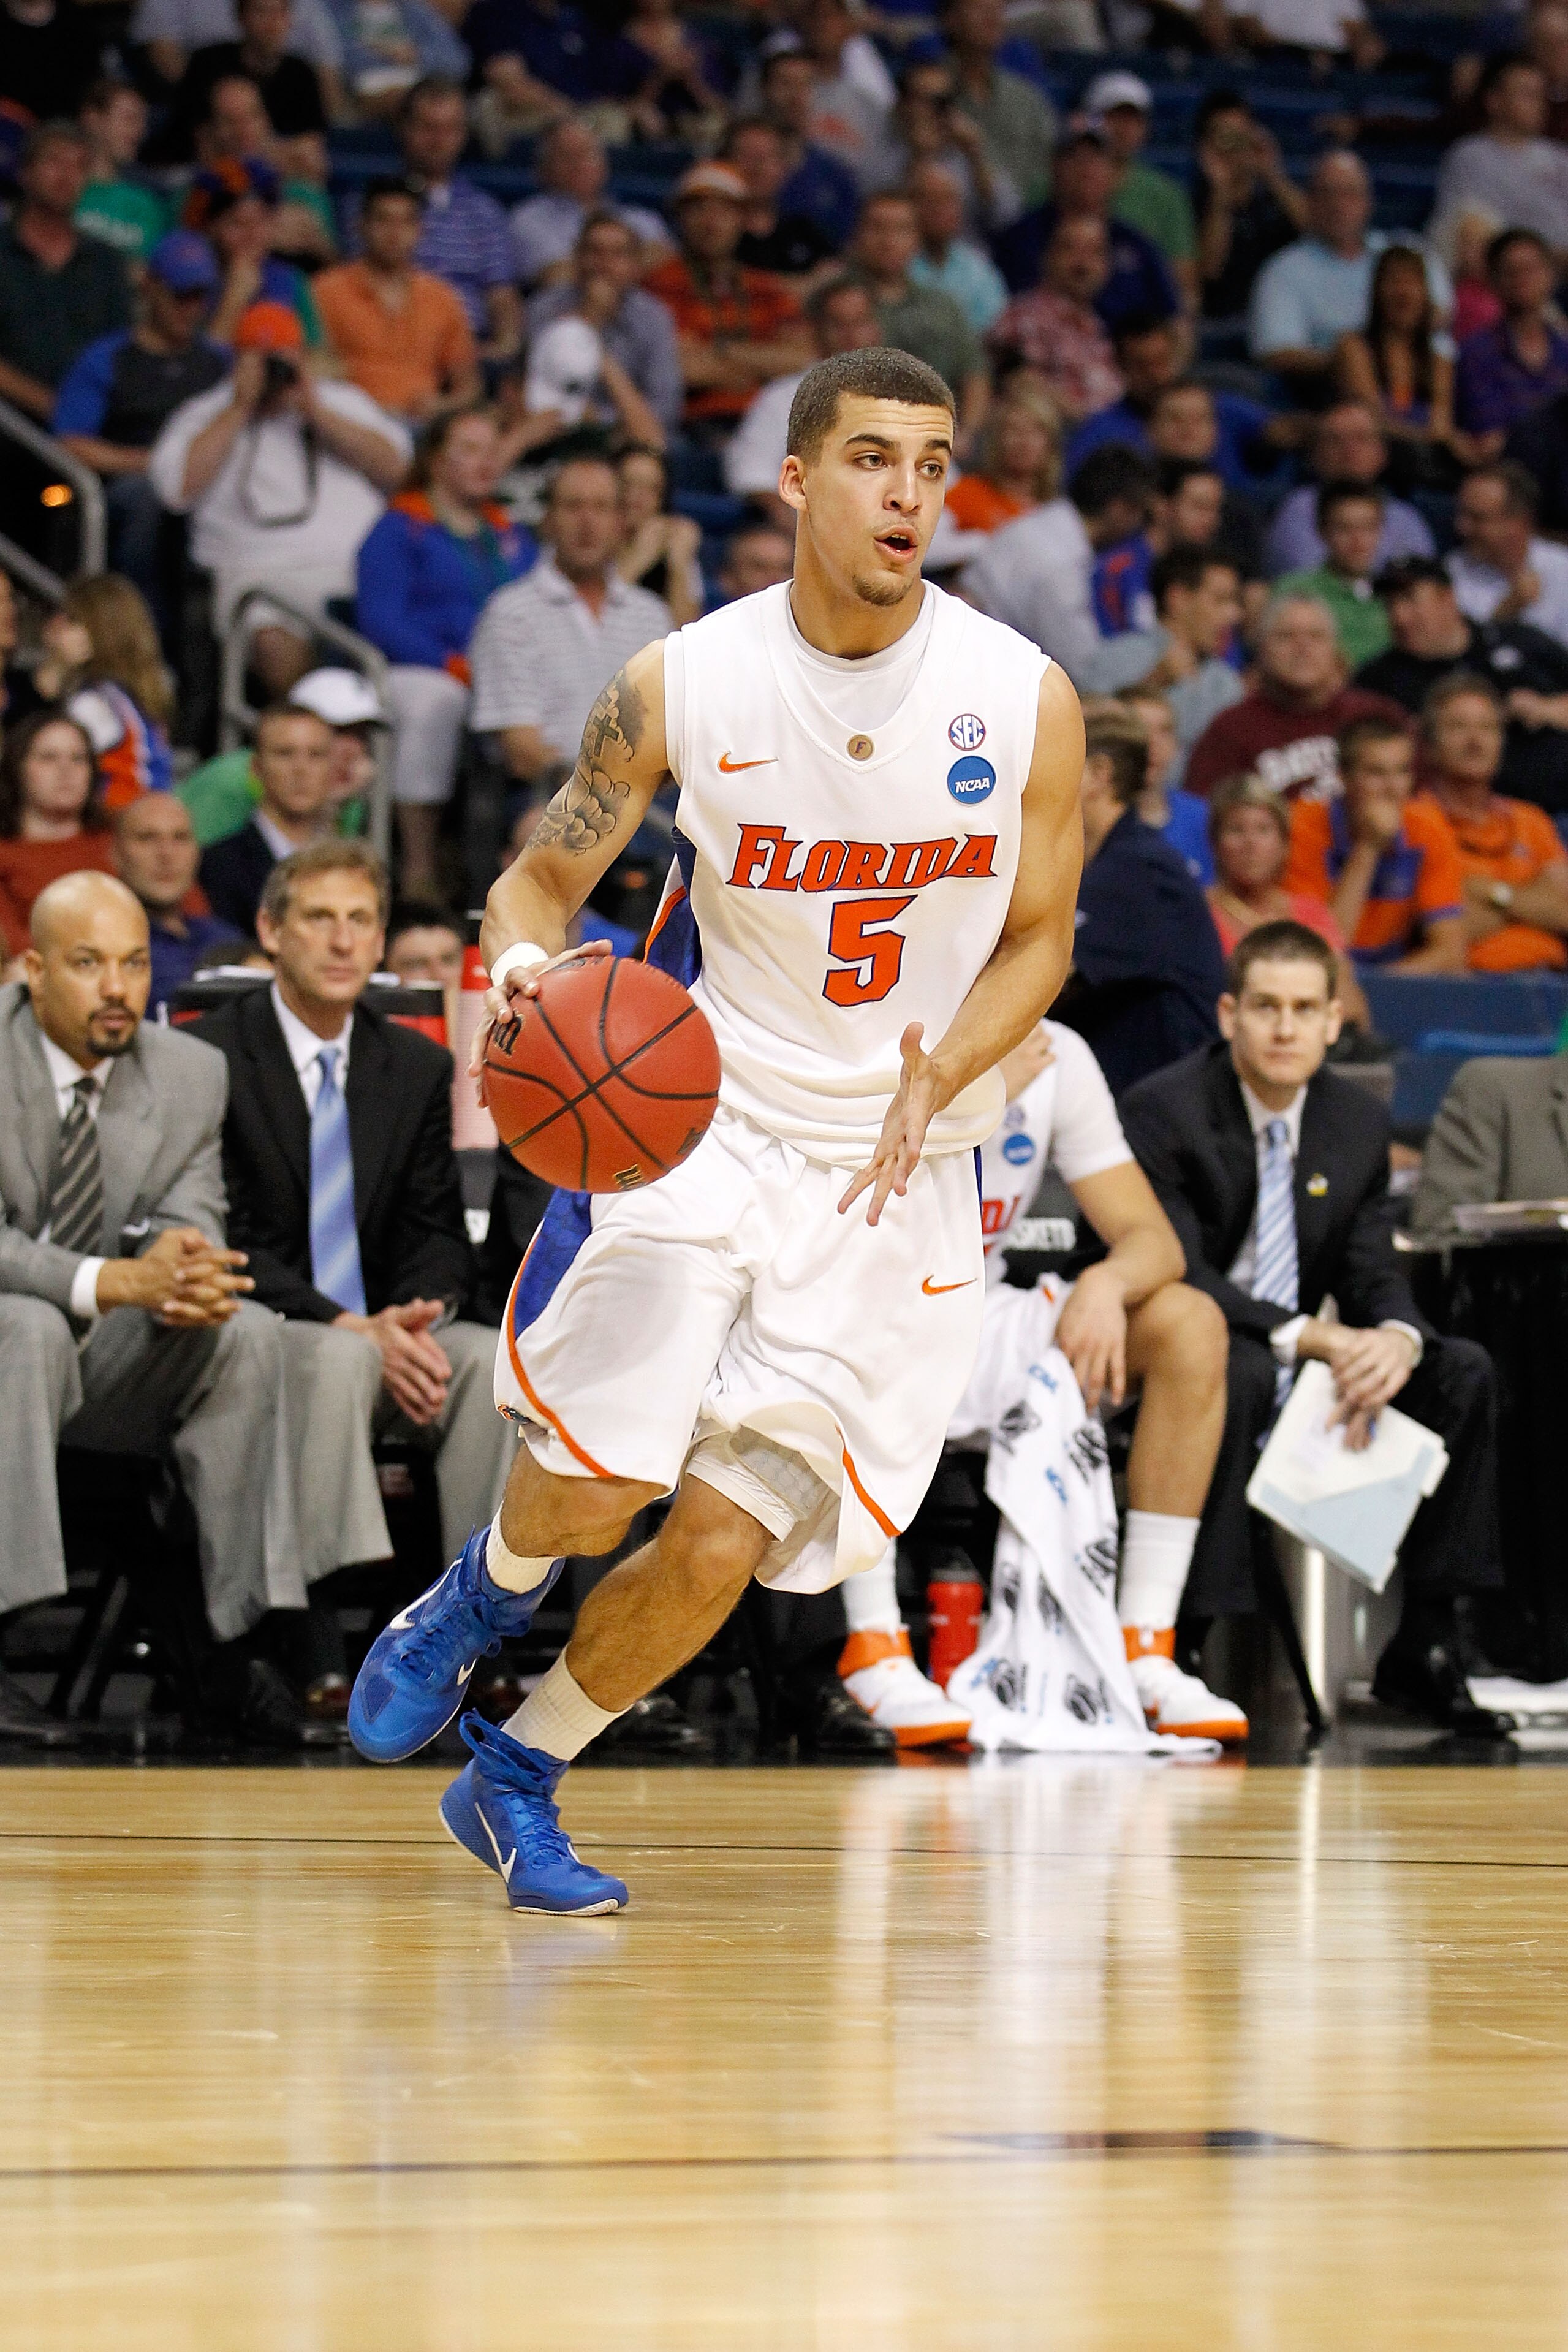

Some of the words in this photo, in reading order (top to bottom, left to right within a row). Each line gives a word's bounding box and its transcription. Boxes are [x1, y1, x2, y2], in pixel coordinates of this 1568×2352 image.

[950, 715, 984, 749] SEC
[955, 776, 990, 794] NCAA
[725, 822, 999, 893] FLORIDA
[822, 894, 919, 1008] 5
